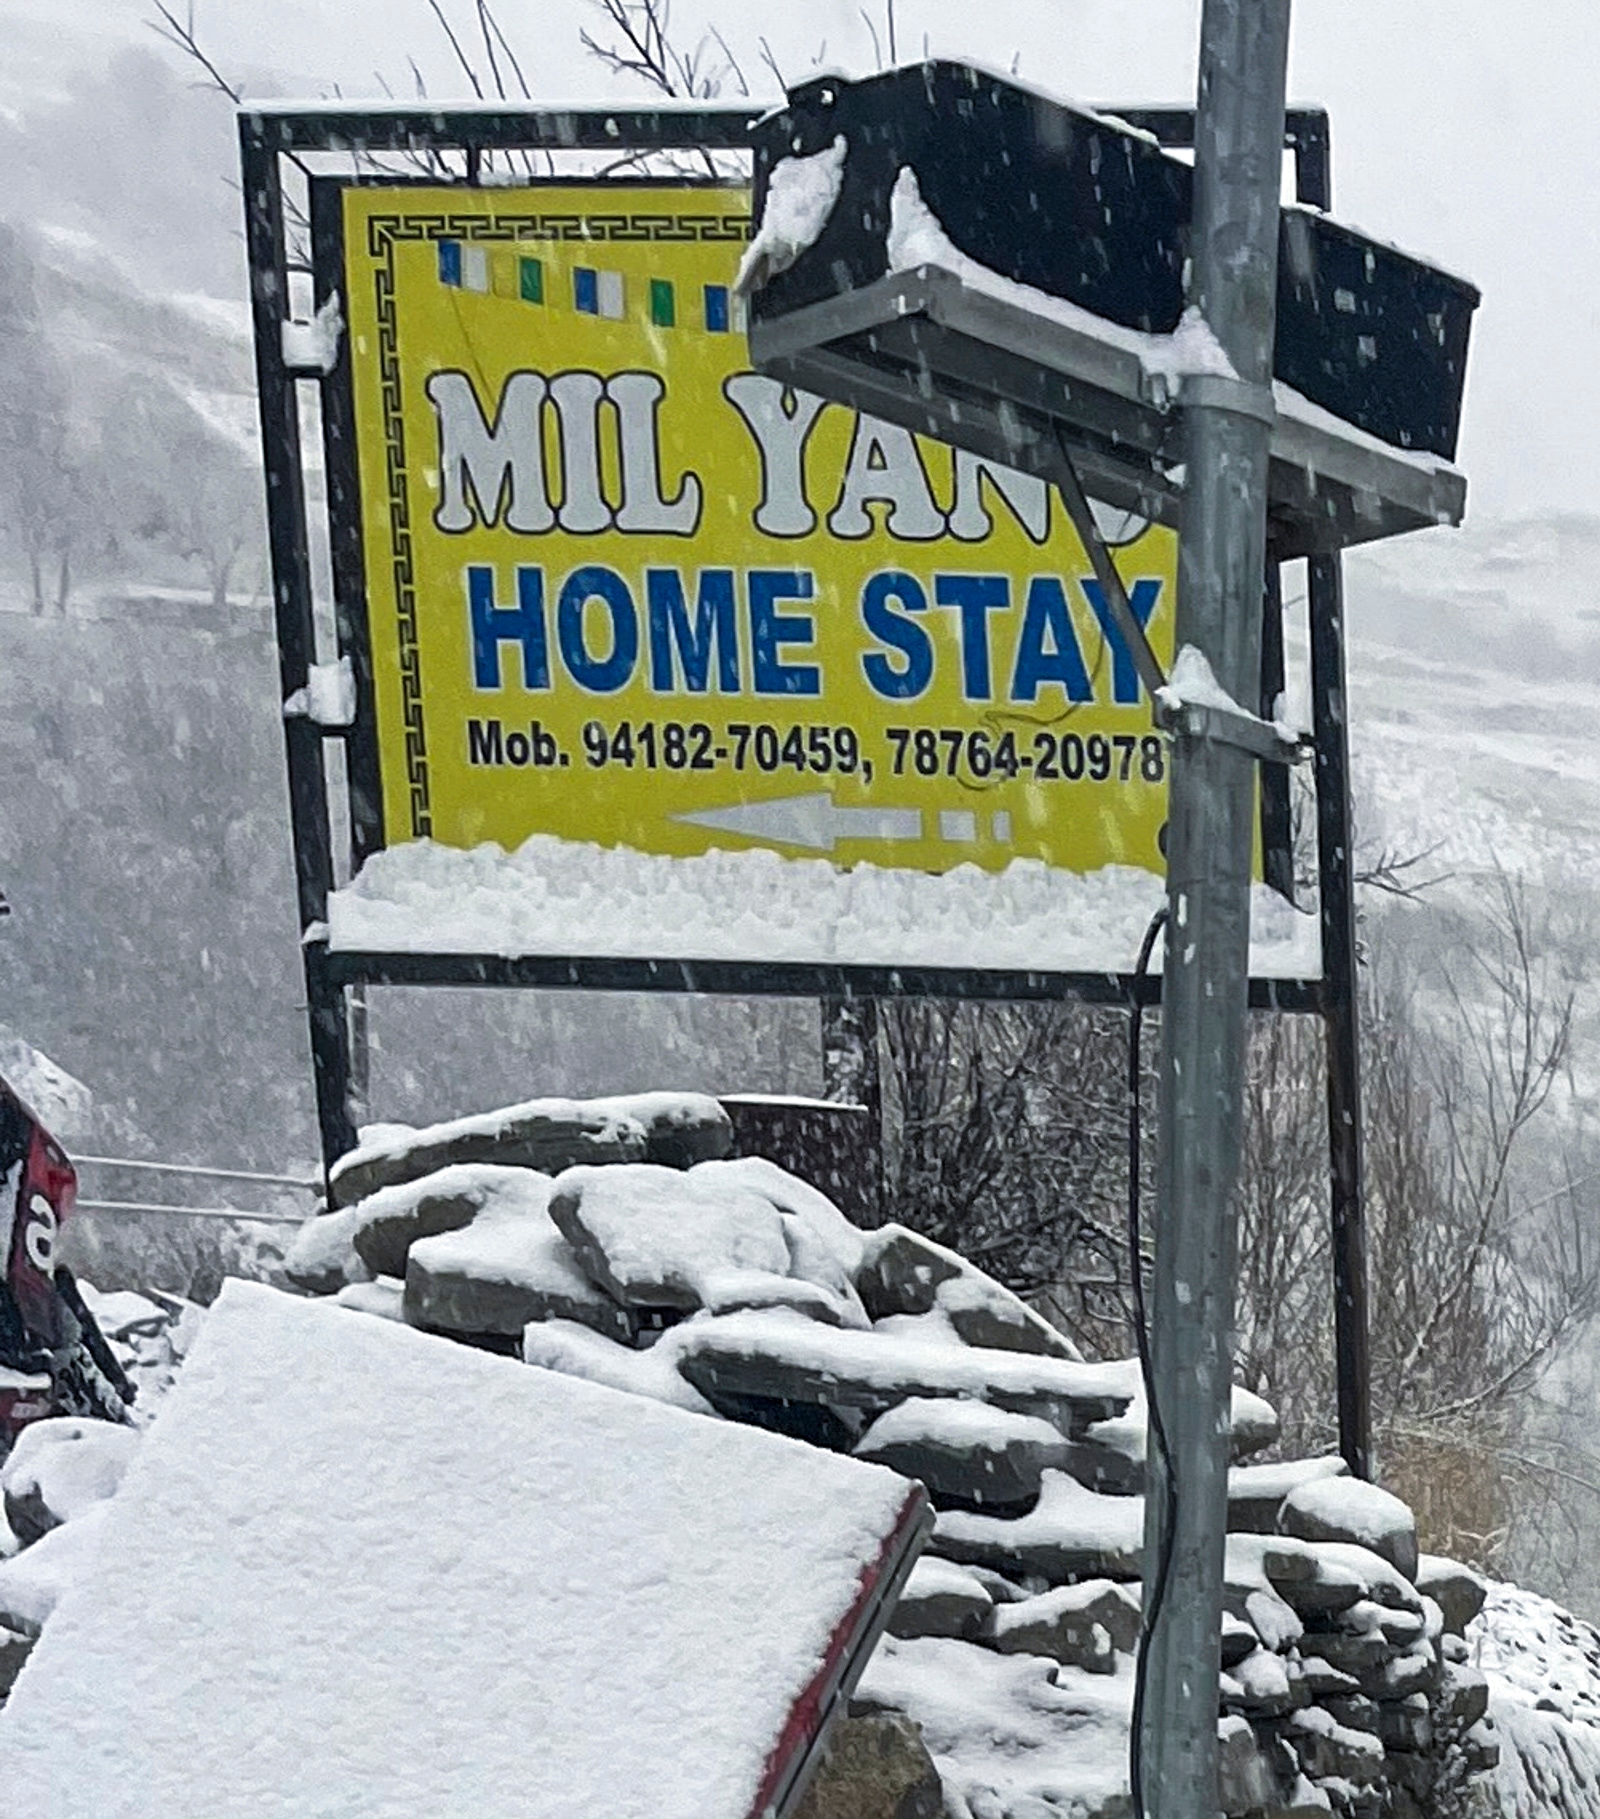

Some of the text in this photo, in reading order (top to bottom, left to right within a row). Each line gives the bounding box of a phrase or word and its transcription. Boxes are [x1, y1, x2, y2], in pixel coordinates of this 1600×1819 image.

[425, 368, 1151, 546] MIL YAN
[466, 565, 1164, 704] HOME STAY
[467, 719, 1164, 784] Mob. 94182-70459, 78764-20978
